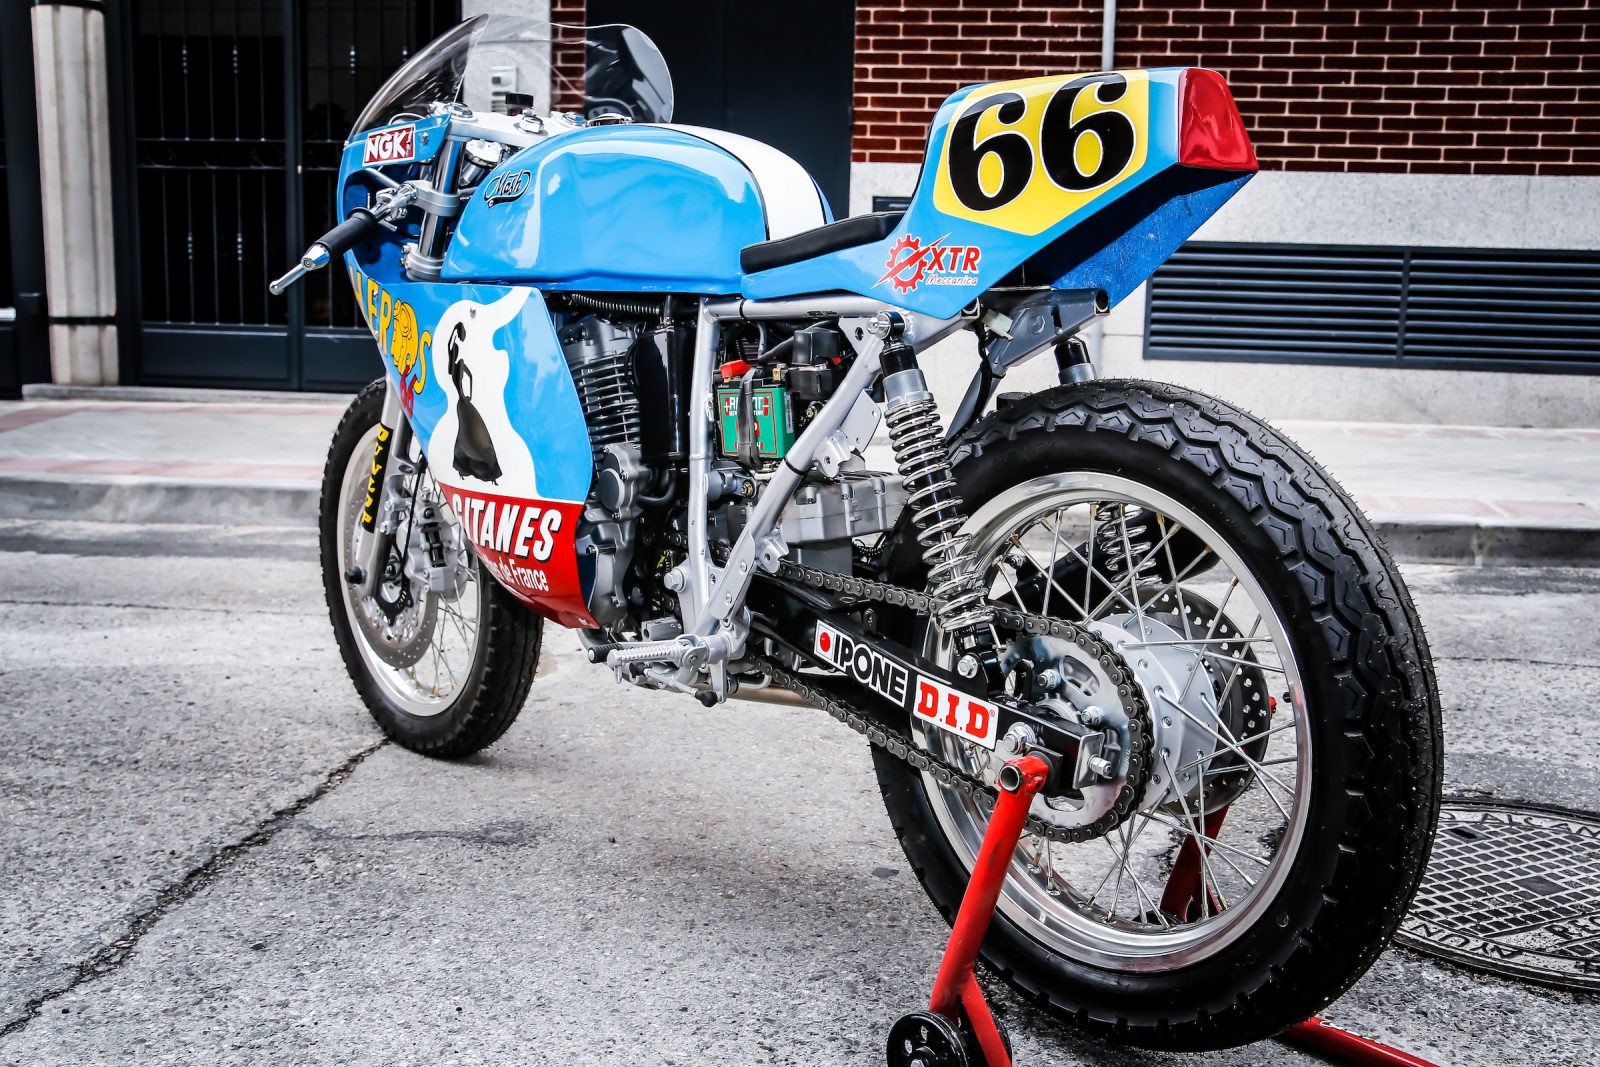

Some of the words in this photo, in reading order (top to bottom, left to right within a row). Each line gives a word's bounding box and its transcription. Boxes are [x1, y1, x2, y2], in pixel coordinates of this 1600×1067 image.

[364, 129, 407, 163] NGK
[948, 72, 1137, 212] 66
[926, 245, 982, 272] XTR
[926, 274, 979, 287] Meccanica
[508, 558, 549, 592] France
[833, 632, 908, 706] IPONE
